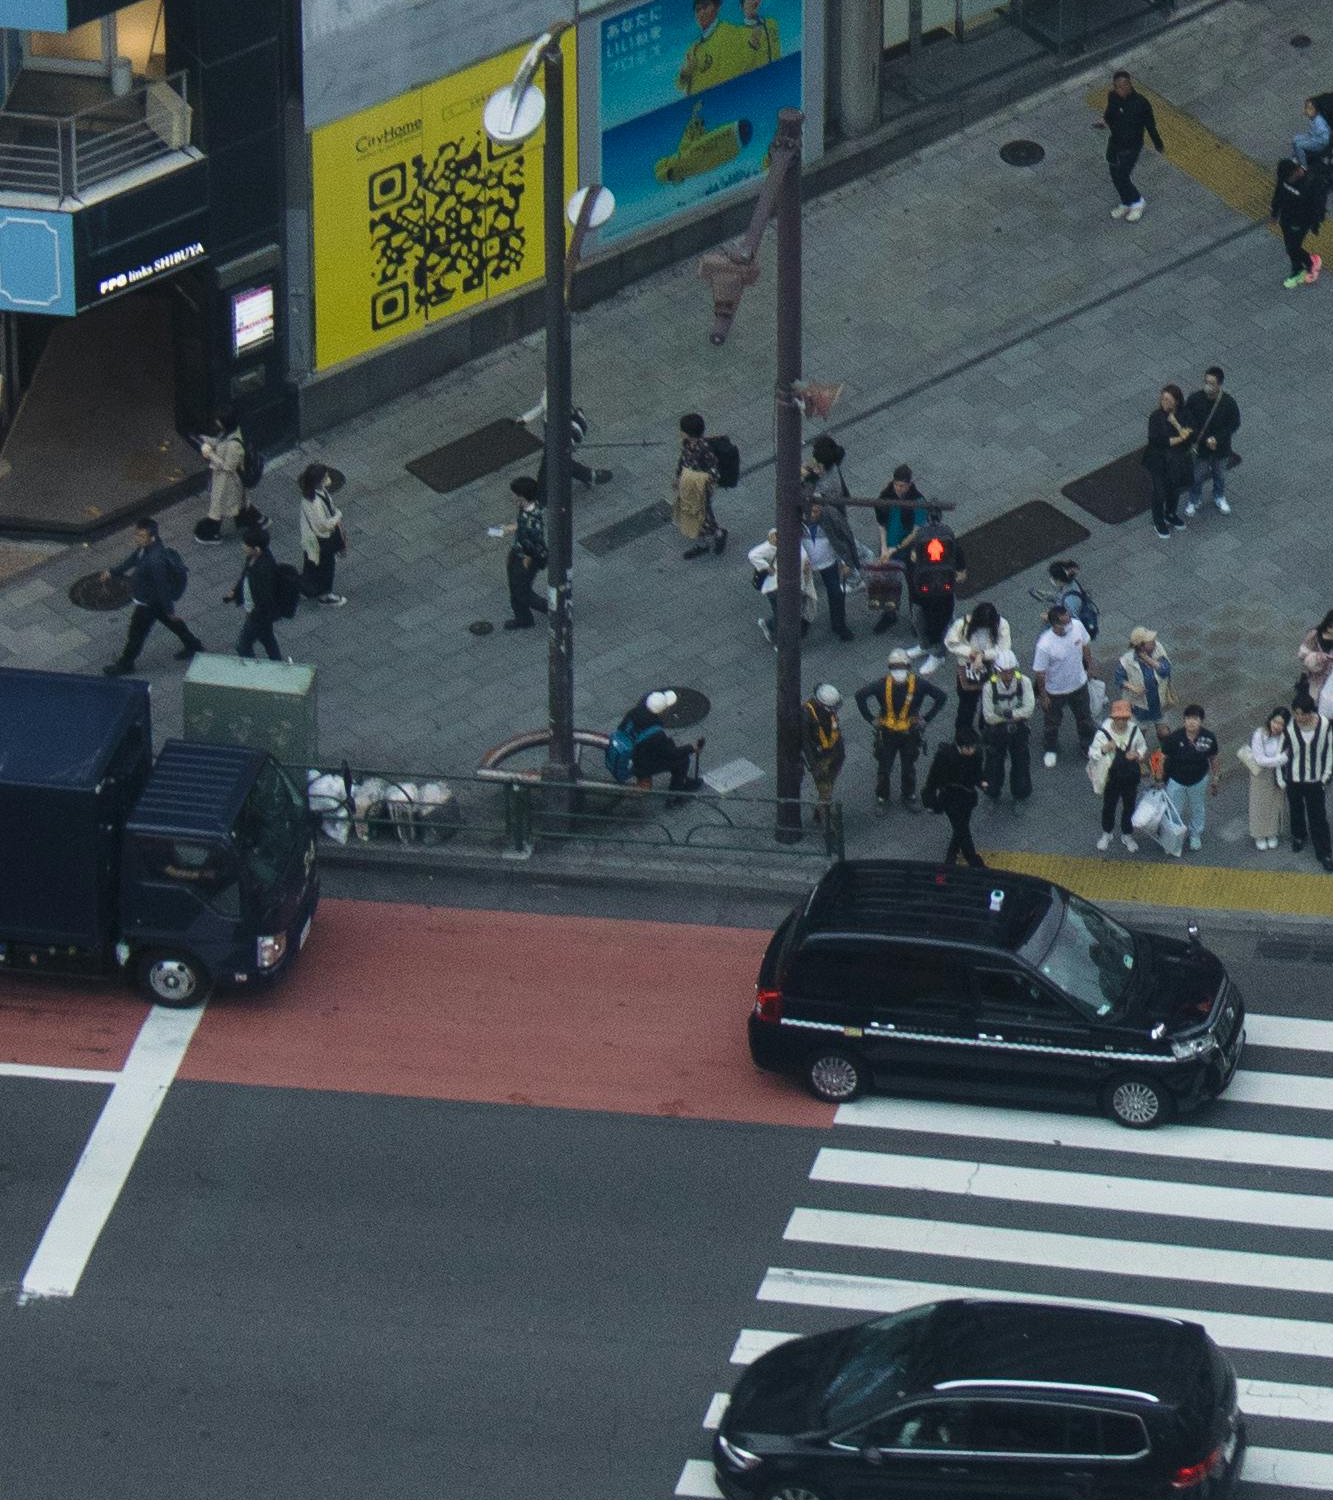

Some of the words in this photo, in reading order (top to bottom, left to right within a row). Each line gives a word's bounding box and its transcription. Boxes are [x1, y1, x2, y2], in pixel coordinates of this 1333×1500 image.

[355, 117, 424, 154] CityHome
[128, 264, 154, 284] links
[153, 241, 206, 273] SHIBUYA
